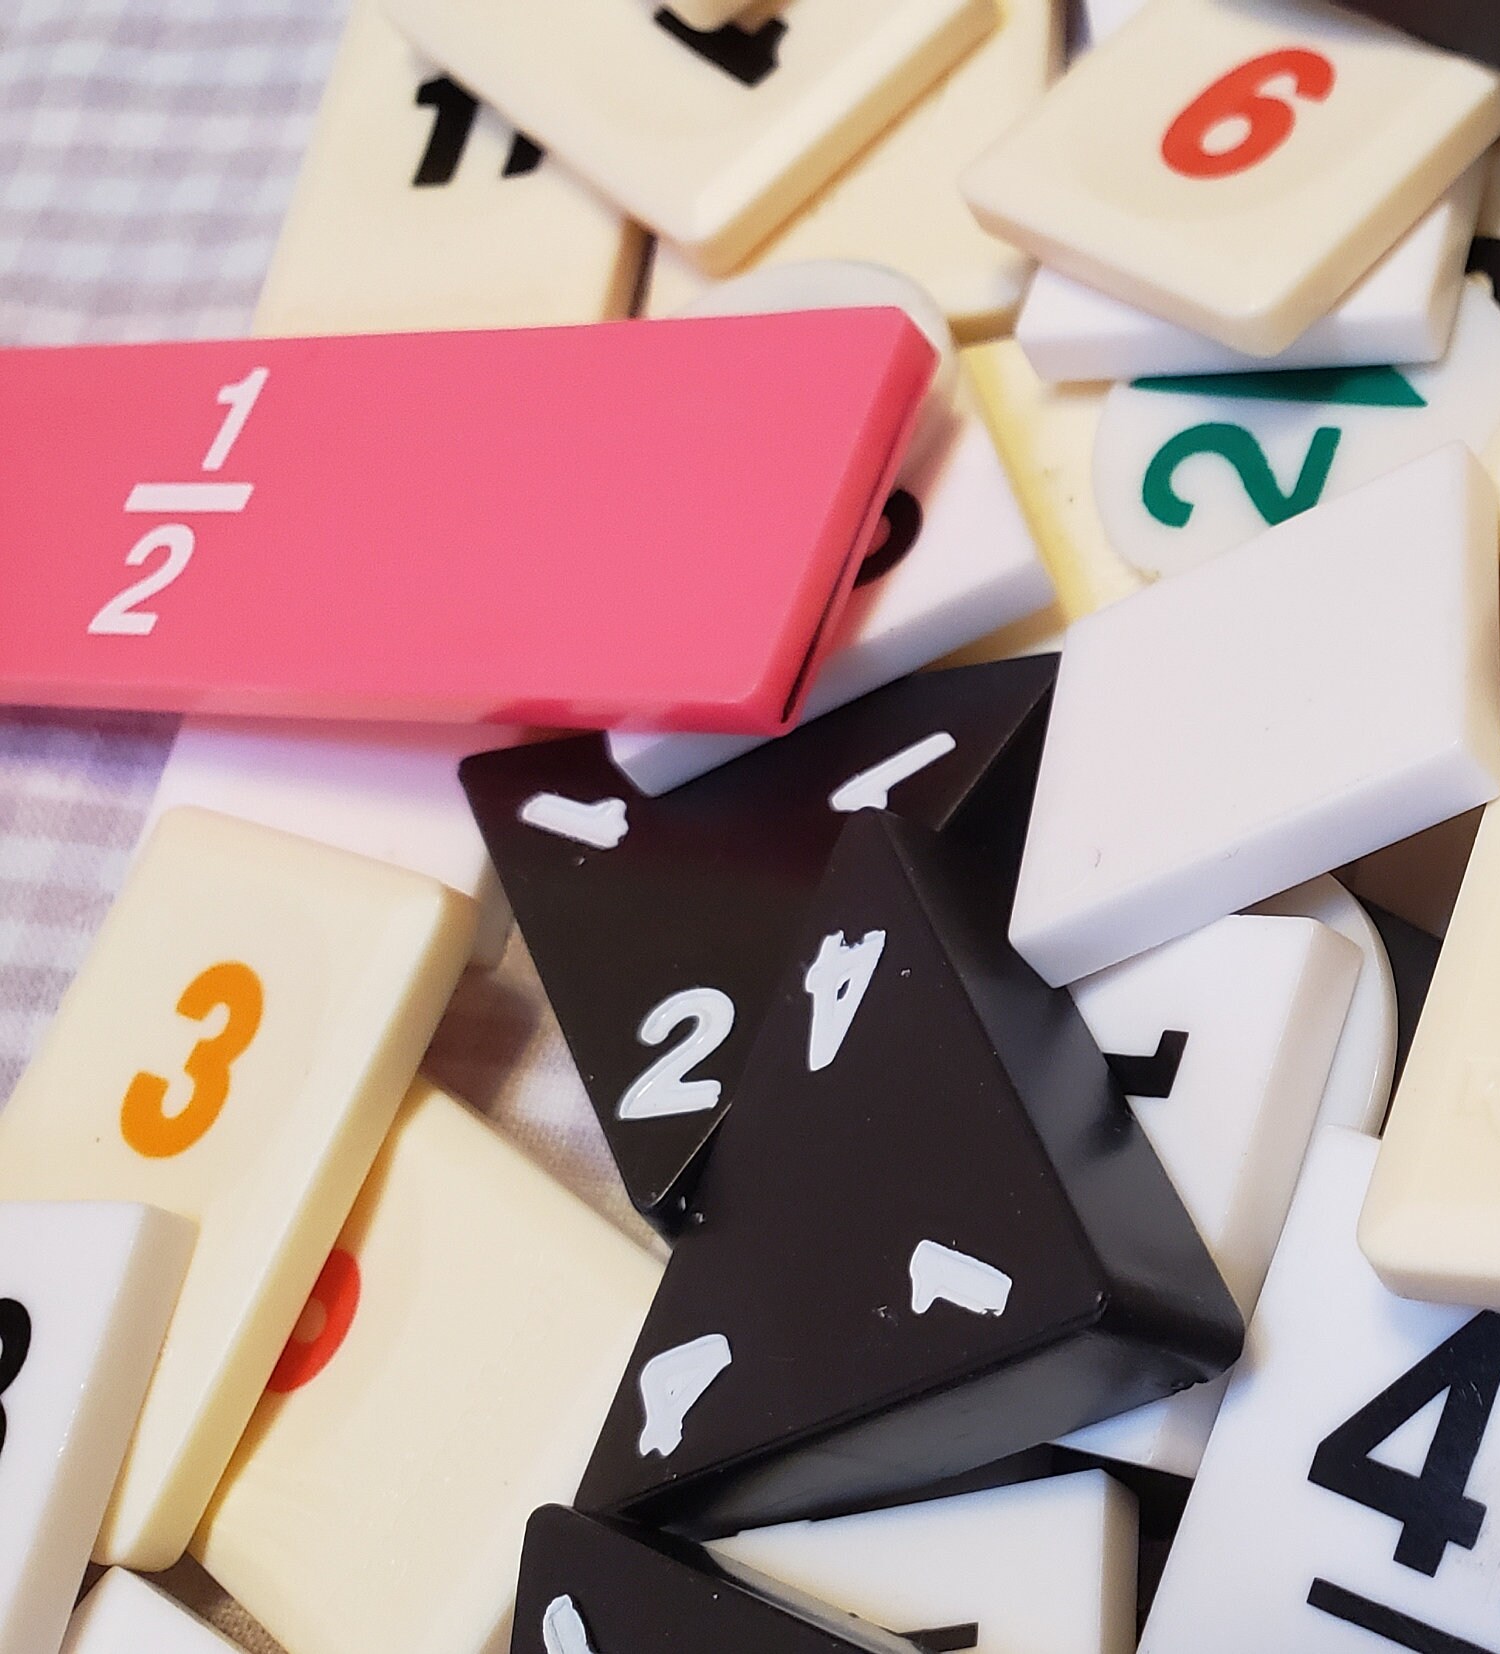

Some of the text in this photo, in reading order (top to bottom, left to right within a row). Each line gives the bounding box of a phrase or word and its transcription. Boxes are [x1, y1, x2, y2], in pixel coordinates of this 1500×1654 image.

[411, 74, 546, 187] 1
[1160, 47, 1336, 180] 6
[1142, 422, 1342, 527] 2
[120, 961, 264, 1159] 3
[618, 987, 736, 1118] 2
